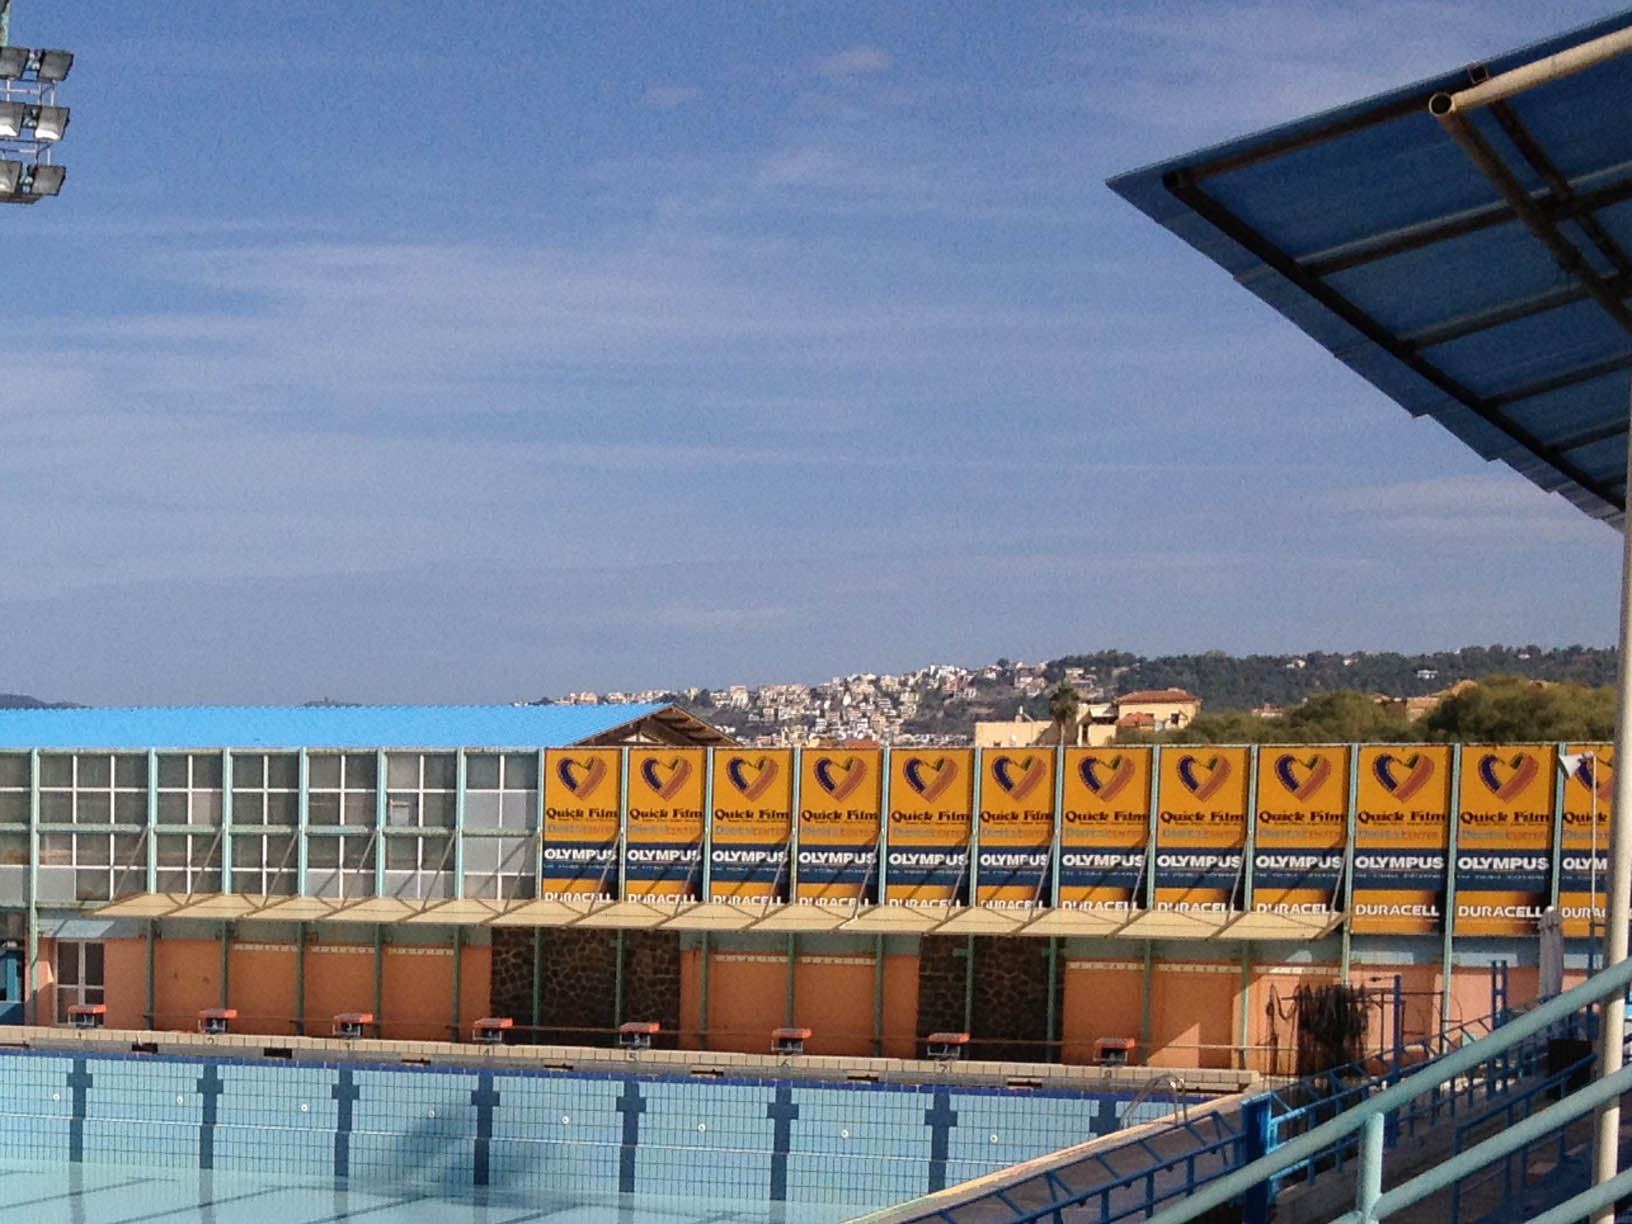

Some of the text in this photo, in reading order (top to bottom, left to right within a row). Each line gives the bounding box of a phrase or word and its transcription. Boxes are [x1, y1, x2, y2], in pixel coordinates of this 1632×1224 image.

[546, 808, 617, 819] Quick Film
[630, 808, 702, 819] Quick Film
[715, 809, 789, 820] Quick Film
[802, 810, 878, 821] Quick Film
[892, 811, 969, 822] Quick Film
[981, 811, 1018, 822] Quick
[1065, 811, 1147, 822] Quick Film
[1160, 811, 1244, 823] Quick Film
[1259, 811, 1344, 823] Quick Film
[1358, 811, 1446, 823] Quick Film
[1461, 812, 1550, 824] Quick Film
[544, 849, 617, 860] OLYMPUS
[627, 850, 701, 861] OLYMPUS
[712, 851, 787, 862] OLYMPUS
[799, 852, 877, 864] OLYMPUS
[889, 853, 968, 865] OLYMPUS
[980, 854, 1048, 865] OLYMPUS
[1062, 854, 1144, 866] OLYMPUS
[1157, 855, 1240, 867] OLYMPUS
[1256, 856, 1341, 868] OLYMPUS
[1355, 857, 1444, 869] OLYMPUS
[1458, 857, 1549, 870] OLYMPUS
[1562, 857, 1607, 870] OLYM
[1356, 904, 1440, 916] DURACELL
[1459, 906, 1543, 917] DURACELL
[206, 1037, 215, 1045] 2
[628, 1052, 638, 1062] 5
[938, 1064, 947, 1074] 7
